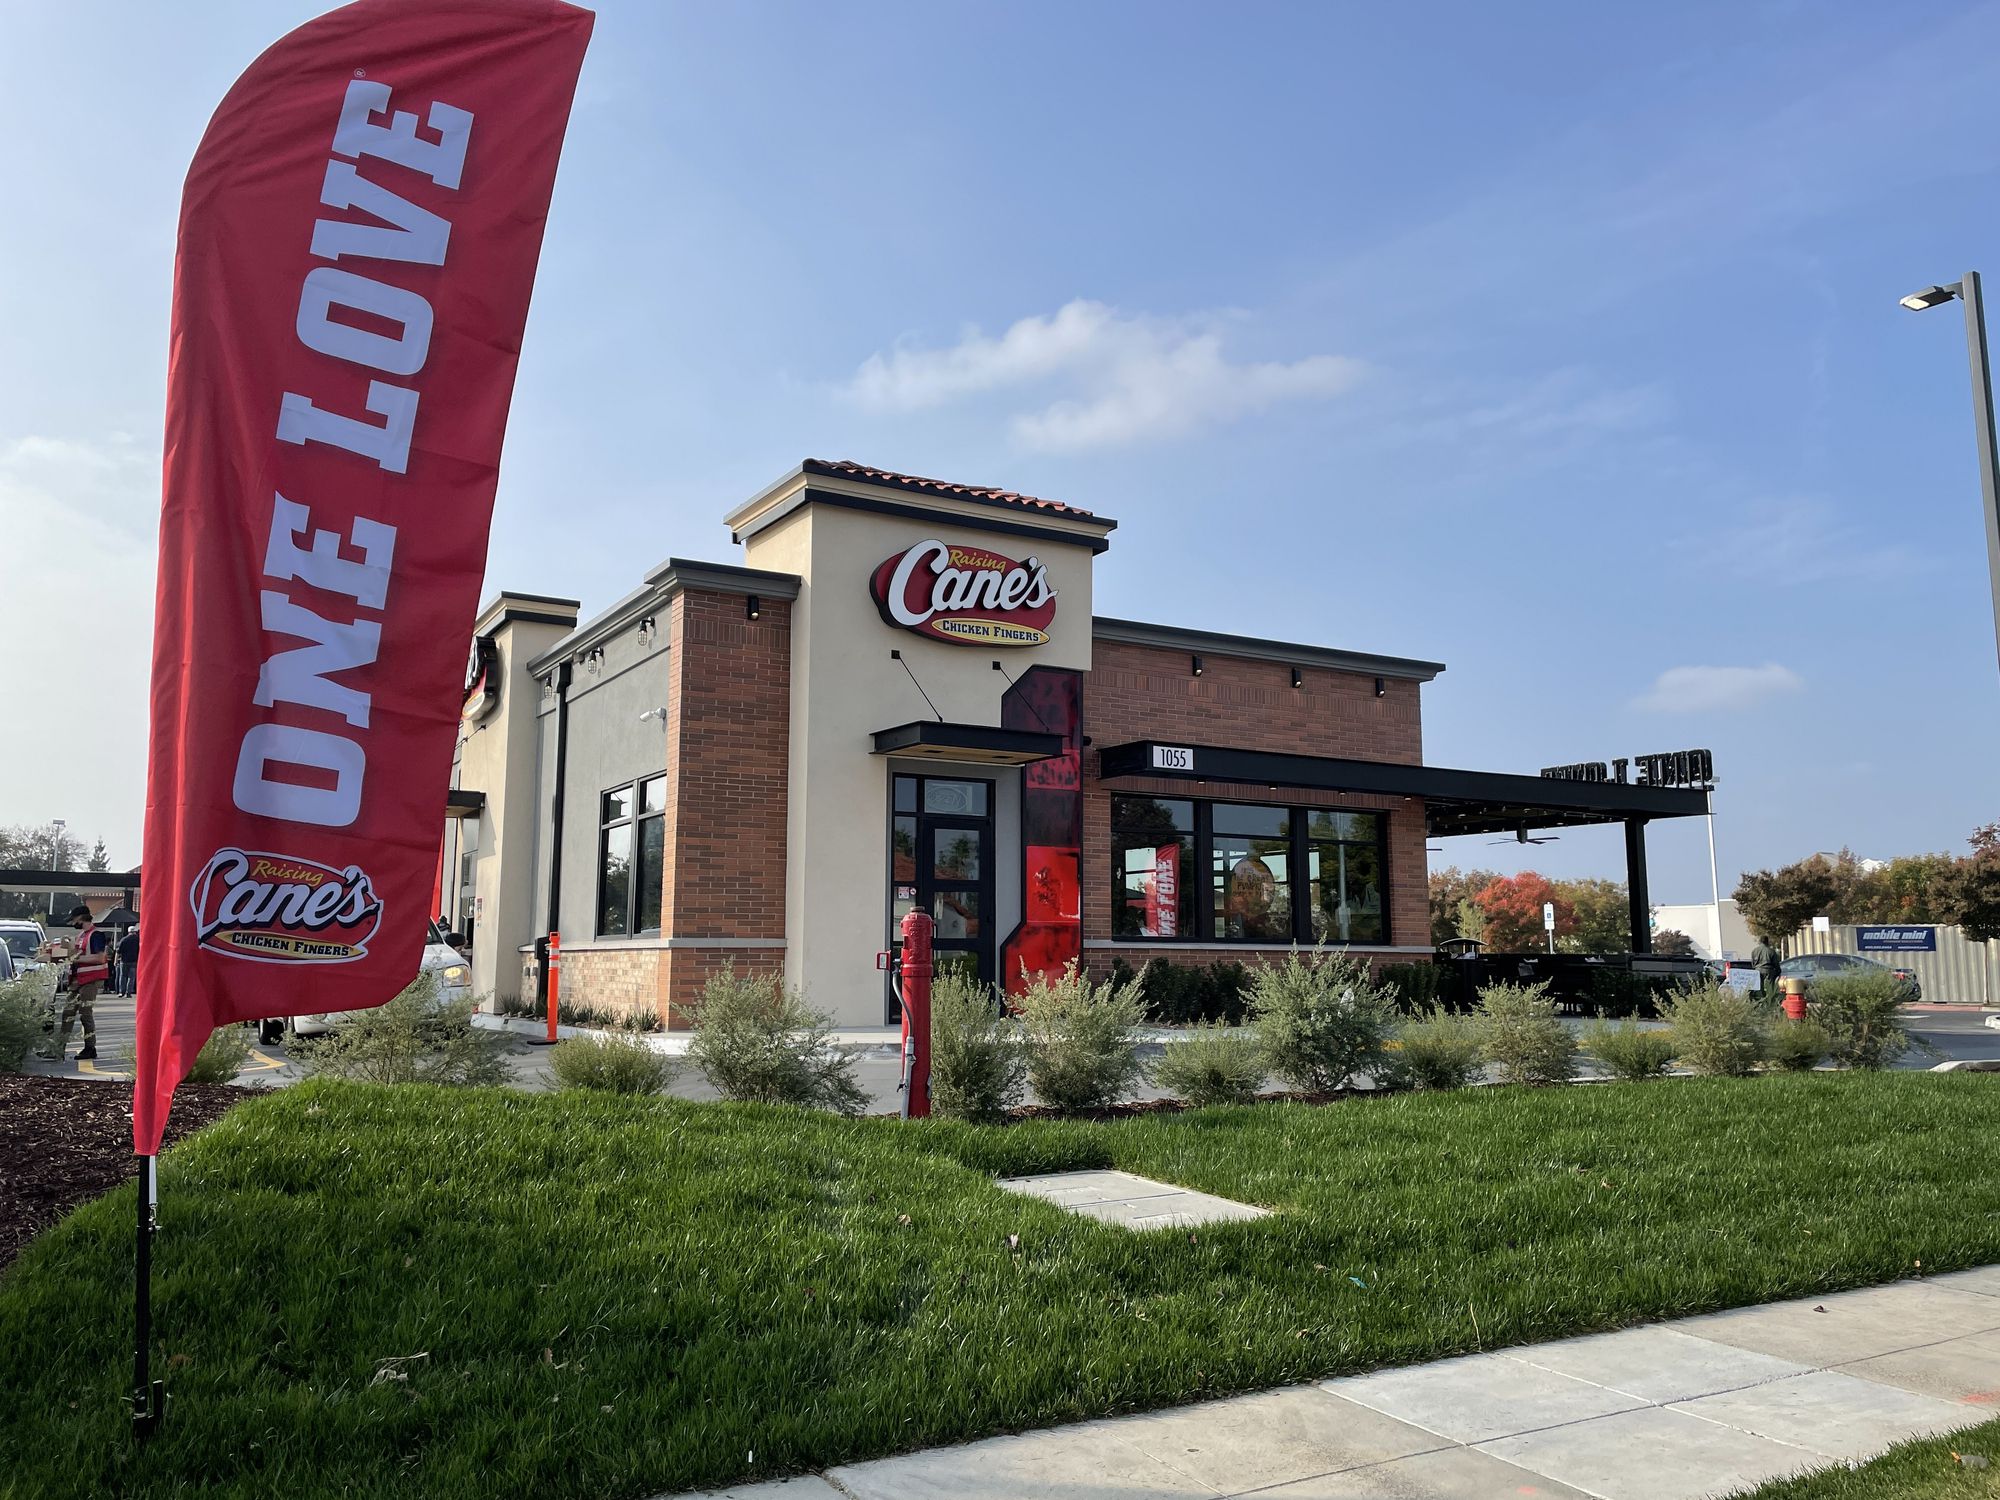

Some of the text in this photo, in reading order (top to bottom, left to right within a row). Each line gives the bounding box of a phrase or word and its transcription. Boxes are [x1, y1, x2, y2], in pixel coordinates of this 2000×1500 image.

[233, 79, 474, 827] ONE LOVE
[948, 549, 1006, 572] Raising
[888, 539, 1059, 626] Cane's
[942, 620, 1040, 642] CHICKEN FINGERS
[1160, 748, 1187, 767] 1055
[251, 859, 324, 887] Raising
[200, 849, 379, 935] Cane's
[231, 932, 350, 957] CHICKEN FINGERS
[1862, 929, 1928, 940] mobile mini
